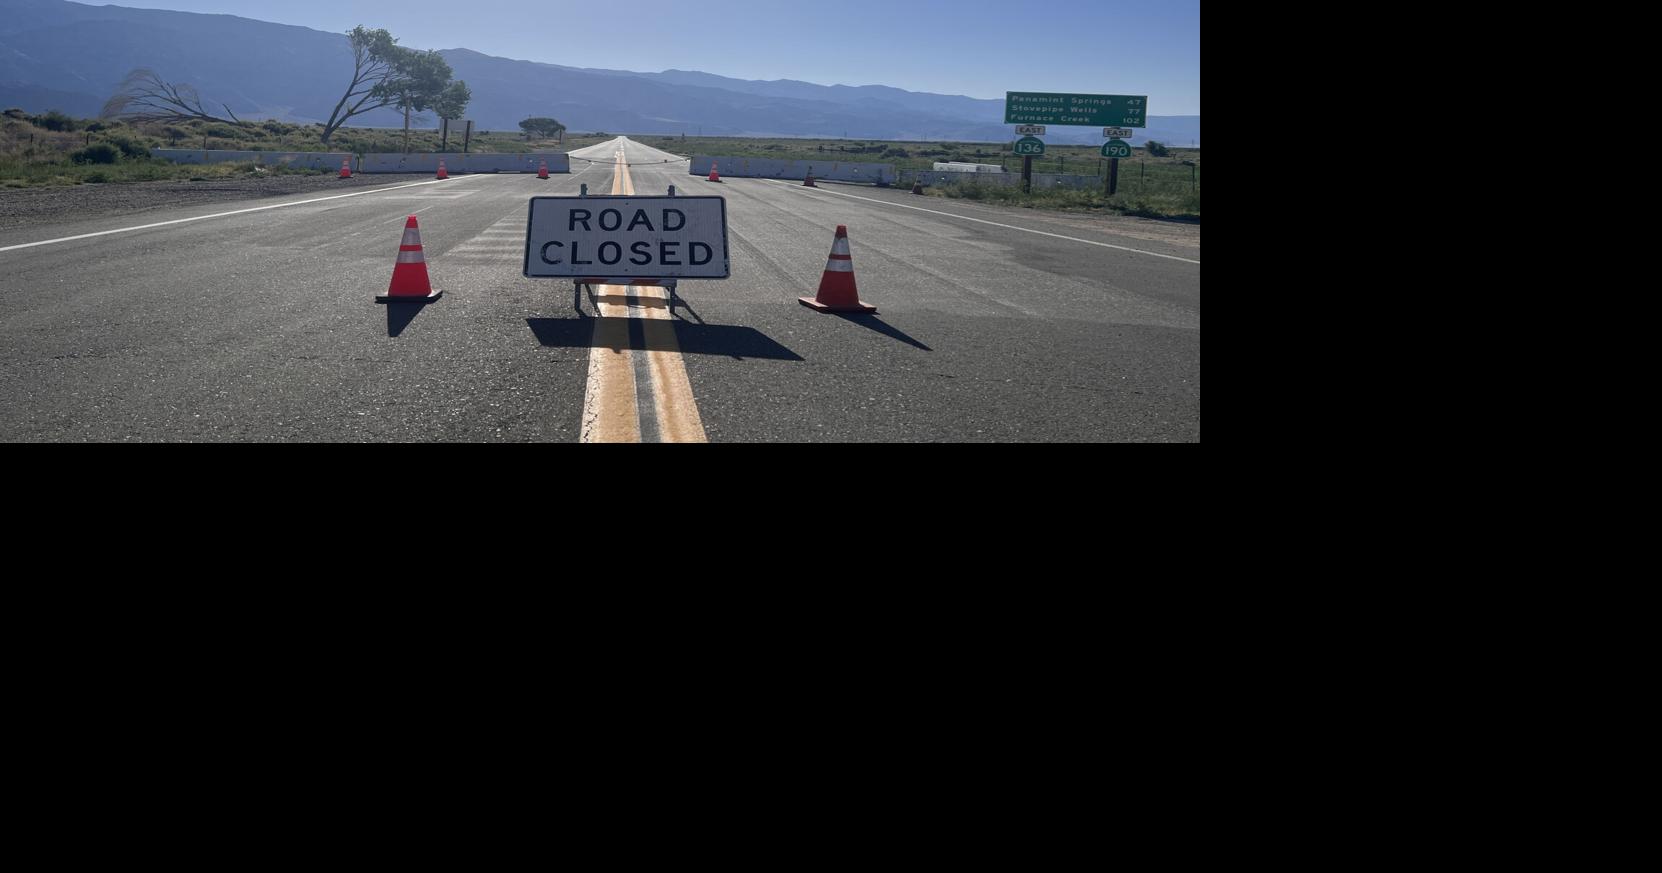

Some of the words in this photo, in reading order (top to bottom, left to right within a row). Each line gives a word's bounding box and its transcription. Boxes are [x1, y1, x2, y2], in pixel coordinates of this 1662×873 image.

[1012, 96, 1064, 104] Panamint
[1071, 98, 1112, 106] Springs
[1012, 104, 1064, 113] Stovepipe
[1018, 144, 1041, 152] 136
[1106, 146, 1128, 156] 190
[568, 208, 687, 232] ROAD
[540, 240, 714, 266] CLOSED
